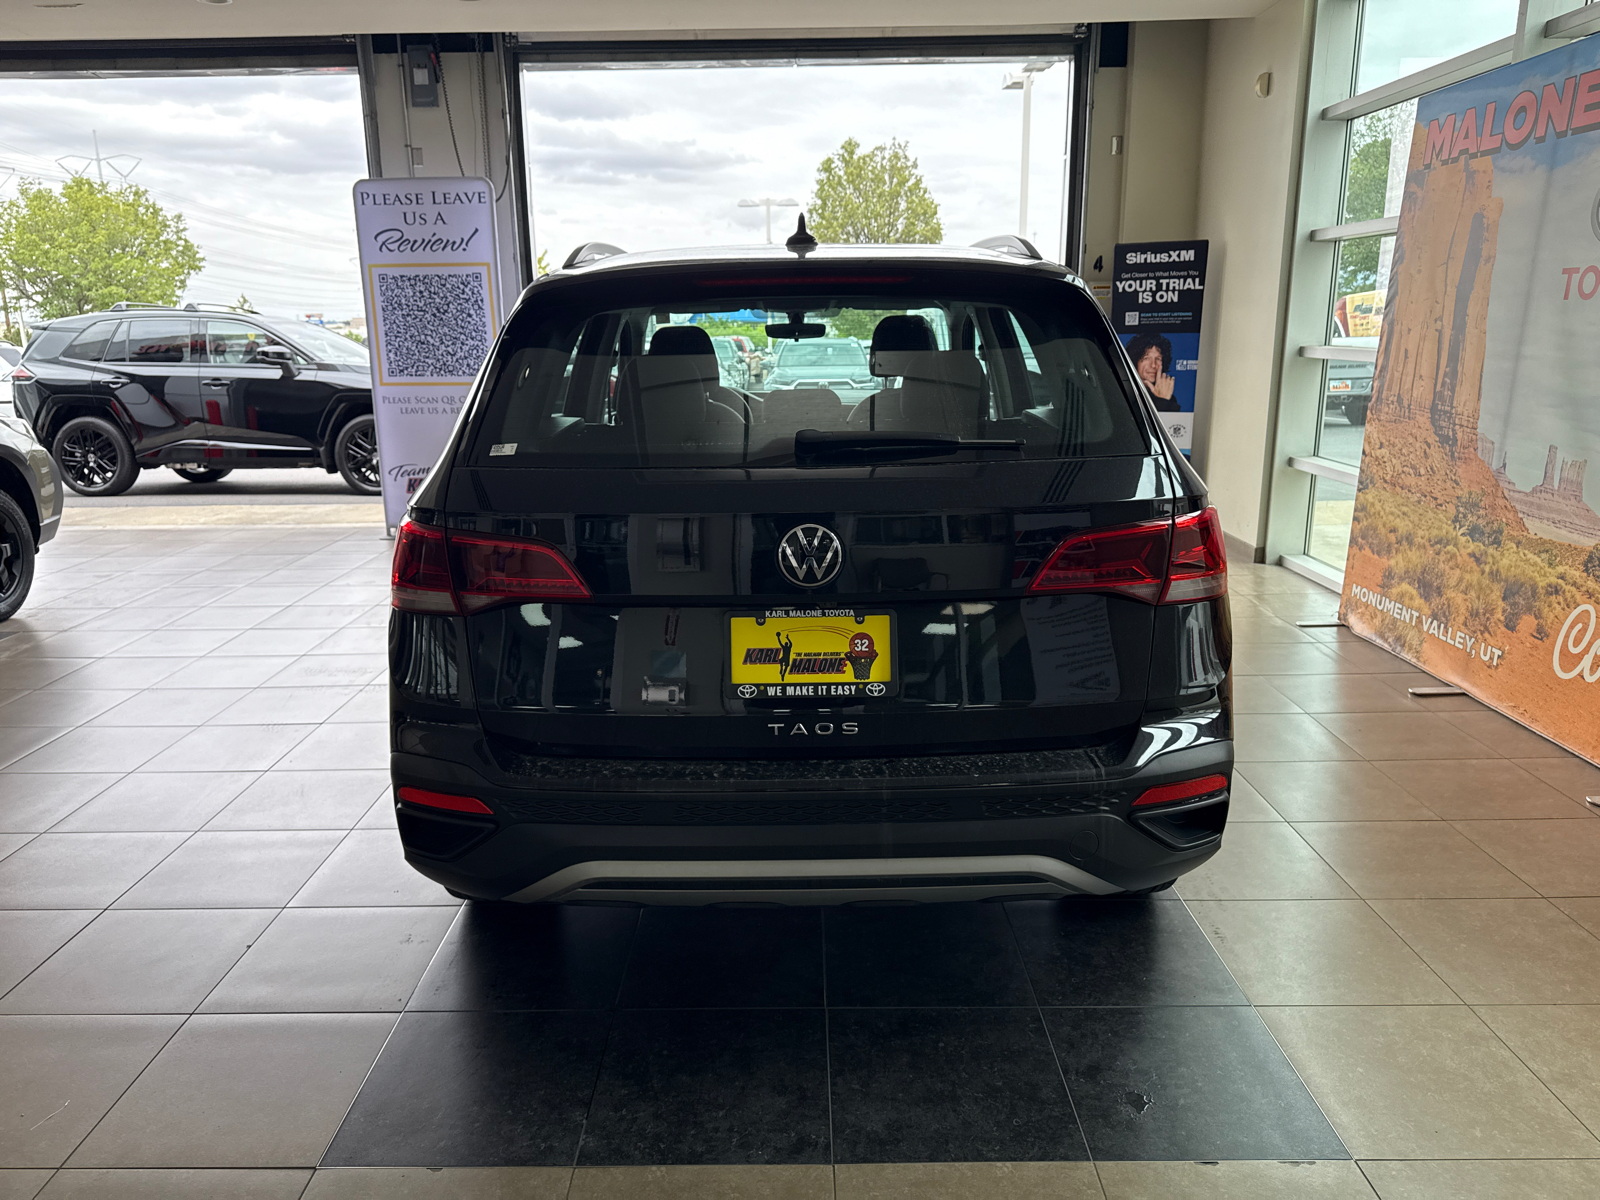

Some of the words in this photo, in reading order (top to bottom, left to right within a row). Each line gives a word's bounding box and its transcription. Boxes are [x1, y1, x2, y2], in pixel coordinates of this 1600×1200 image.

[1422, 68, 1600, 171] MALONE
[359, 191, 424, 206] PLEASE
[431, 190, 487, 206] LEAVE
[433, 211, 448, 226] A
[374, 227, 479, 253] Review!
[1093, 254, 1104, 273] 4
[1125, 249, 1195, 264] SiriusXM
[1116, 279, 1156, 293] YOUR
[1159, 277, 1204, 291] TRIAL
[1138, 291, 1153, 304] IS
[1155, 290, 1178, 303] ON
[441, 395, 457, 405] QR
[400, 407, 425, 415] LEAVE
[428, 407, 439, 415] US
[765, 610, 787, 618] KARL
[789, 610, 822, 618] MALONE
[824, 609, 855, 617] TOYOTA
[1351, 583, 1420, 627] MONUMENT
[1421, 614, 1477, 659] VALLEY,
[1479, 642, 1503, 667] UT
[854, 639, 869, 652] 32
[742, 648, 782, 665] KARL
[788, 657, 848, 675] MALONE
[767, 686, 782, 696] WE
[786, 685, 814, 696] MAKE
[818, 685, 827, 695] IT
[831, 685, 856, 695] EASY
[767, 722, 859, 736] TAOS
